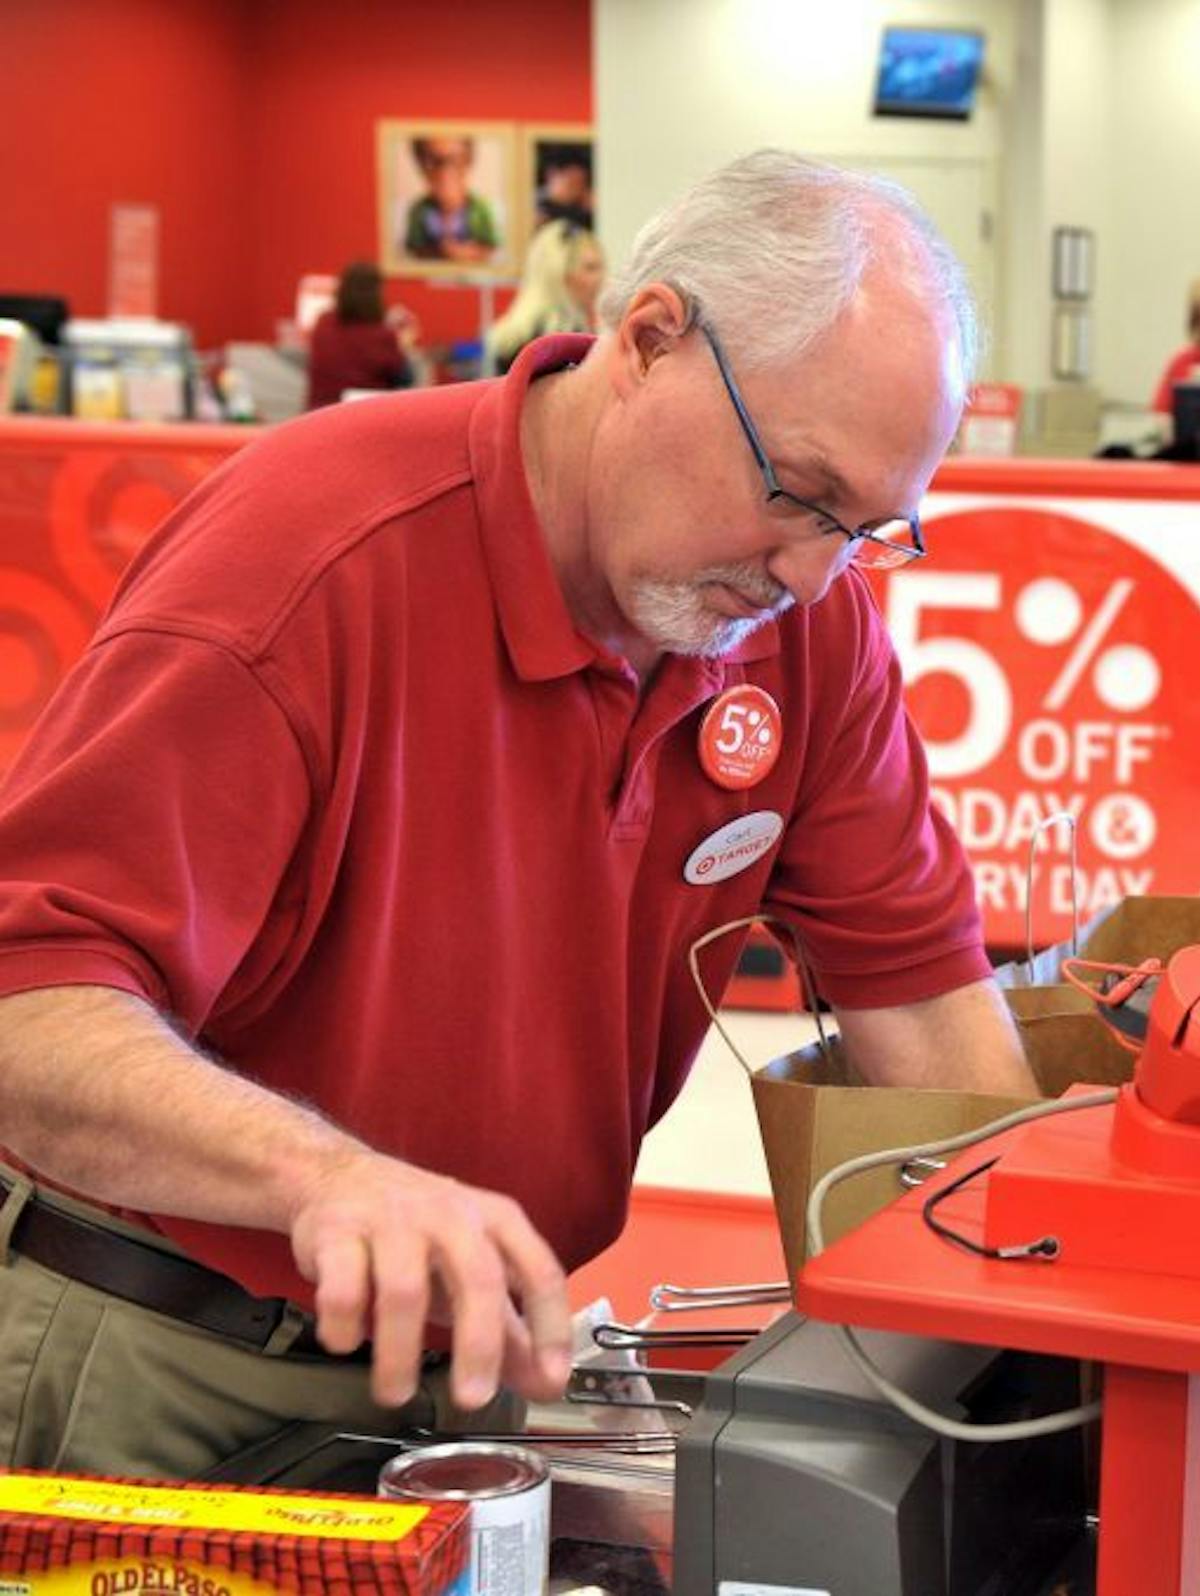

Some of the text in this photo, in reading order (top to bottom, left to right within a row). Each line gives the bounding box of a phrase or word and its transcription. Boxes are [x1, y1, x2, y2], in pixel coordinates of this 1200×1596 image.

[886, 571, 1162, 780] 5%
[715, 703, 770, 753] 5%
[1017, 718, 1158, 784] OFF
[92, 1568, 138, 1596] OLD
